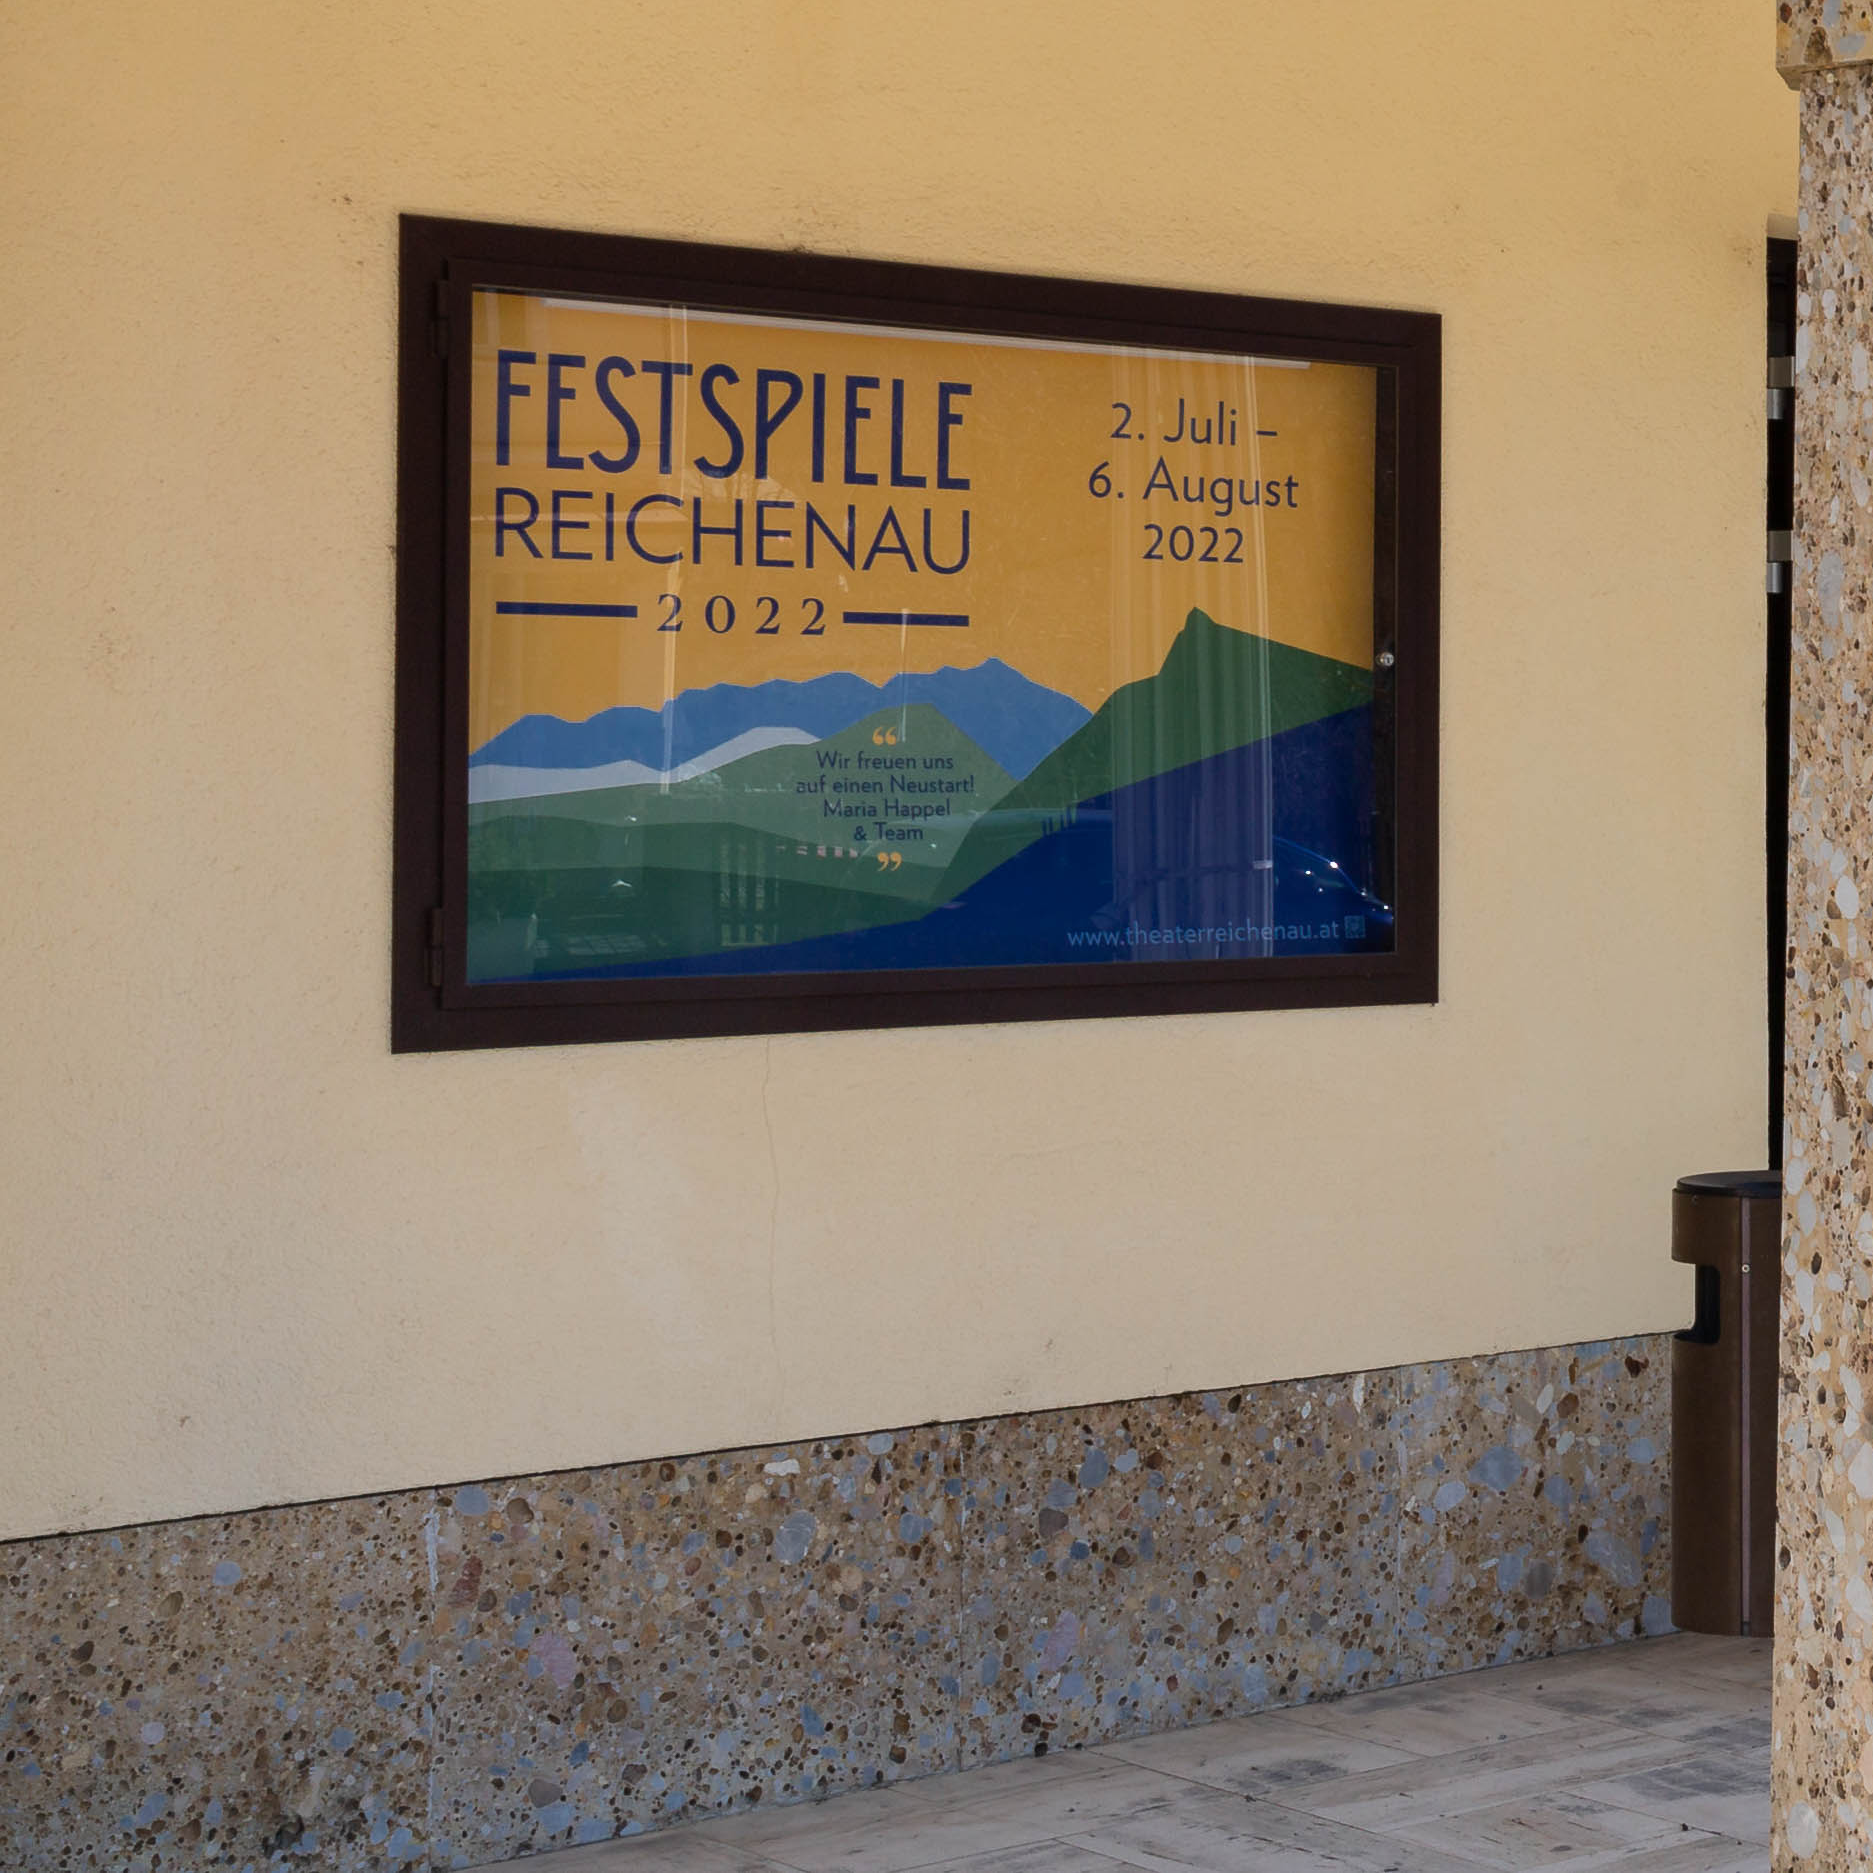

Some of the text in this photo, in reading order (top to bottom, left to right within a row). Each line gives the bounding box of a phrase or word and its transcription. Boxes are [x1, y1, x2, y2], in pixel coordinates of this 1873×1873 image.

[496, 349, 972, 490] FESTSPIELE
[1110, 402, 1144, 440] 2.
[1163, 398, 1237, 446] Juli
[1089, 455, 1299, 517] 6. August
[495, 487, 971, 575] REICHENAU
[1142, 523, 1244, 563] 2022
[656, 593, 826, 636] 2022
[816, 750, 954, 770] Wir freuen uns
[796, 774, 975, 794] auf einen Neustart!
[823, 799, 951, 821] Maria Happel
[853, 822, 924, 841] & Team
[1067, 918, 1340, 947] www.theaterreichenau.at
